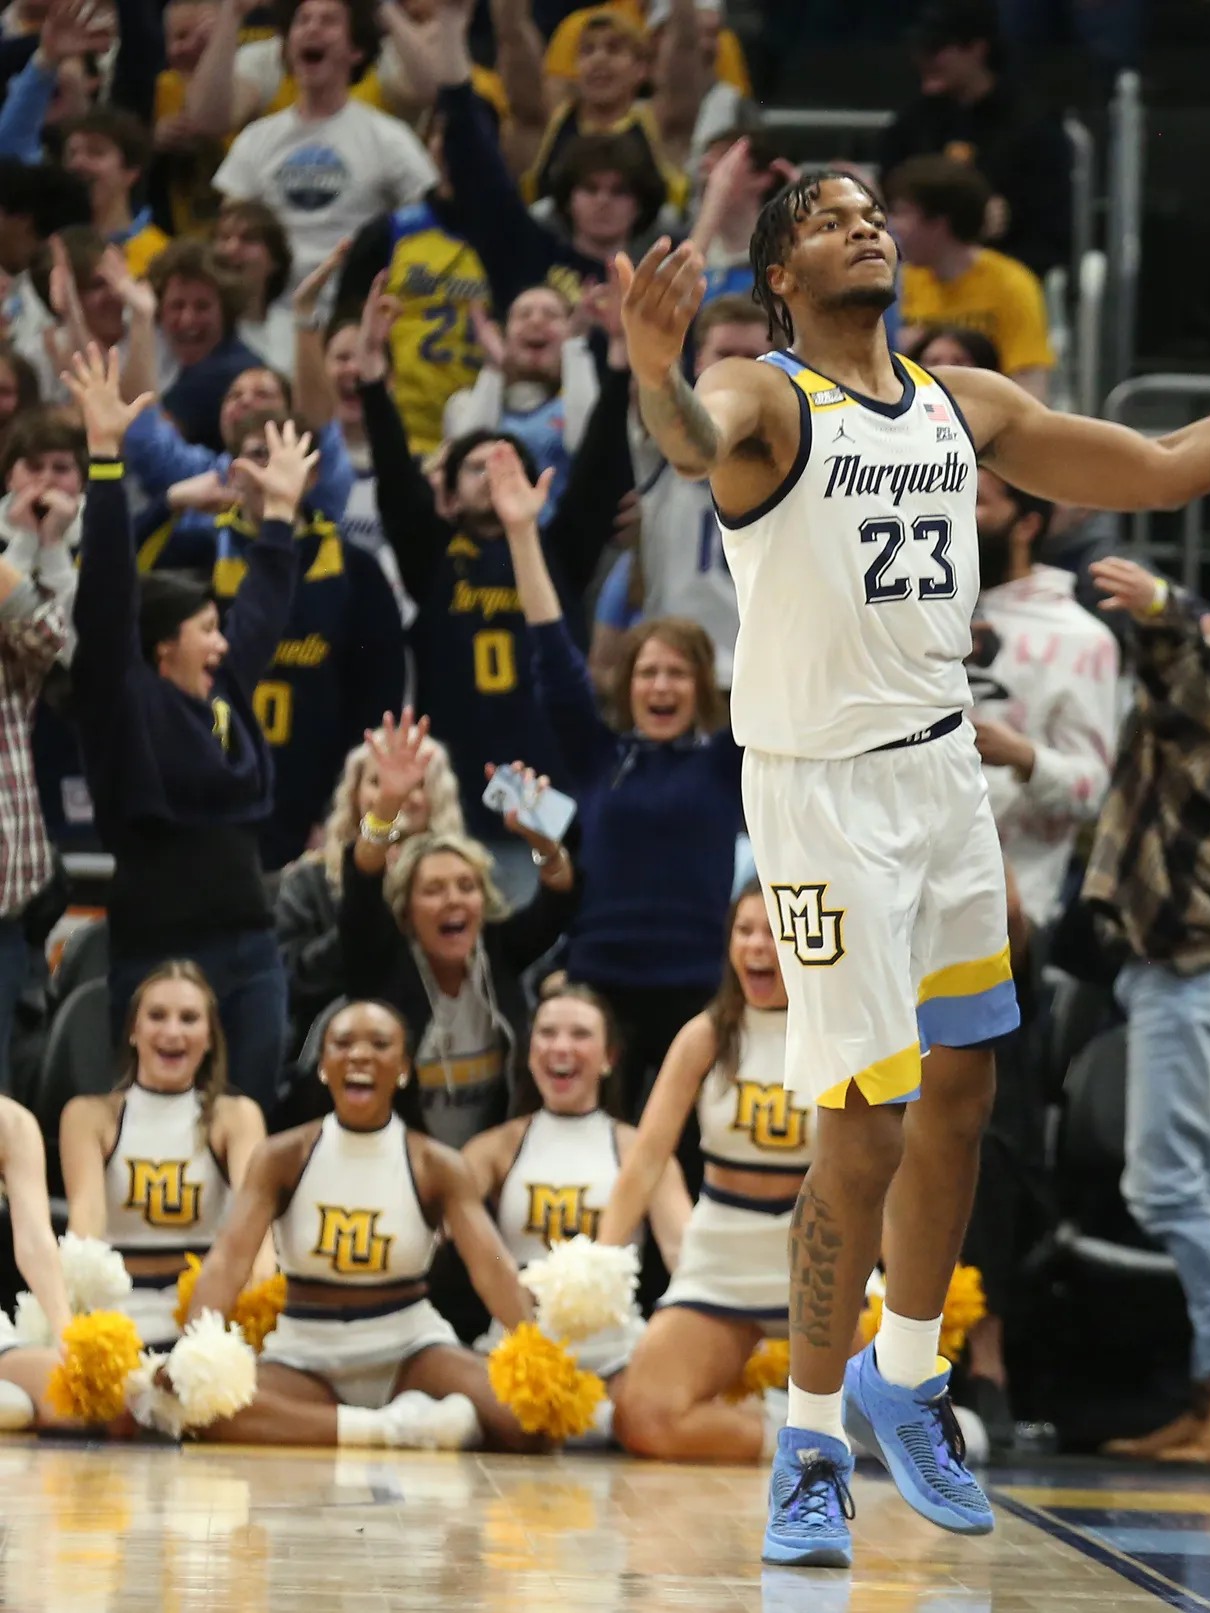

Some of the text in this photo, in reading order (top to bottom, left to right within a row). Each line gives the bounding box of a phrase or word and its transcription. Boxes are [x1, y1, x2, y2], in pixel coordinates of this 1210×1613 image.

[824, 452, 969, 506] Marquette
[858, 514, 958, 604] 23
[473, 629, 517, 694] 0
[253, 680, 293, 746] 0
[770, 883, 845, 967] MU
[731, 1079, 810, 1151] MU
[125, 1158, 204, 1227] MU
[313, 1203, 395, 1273] MU
